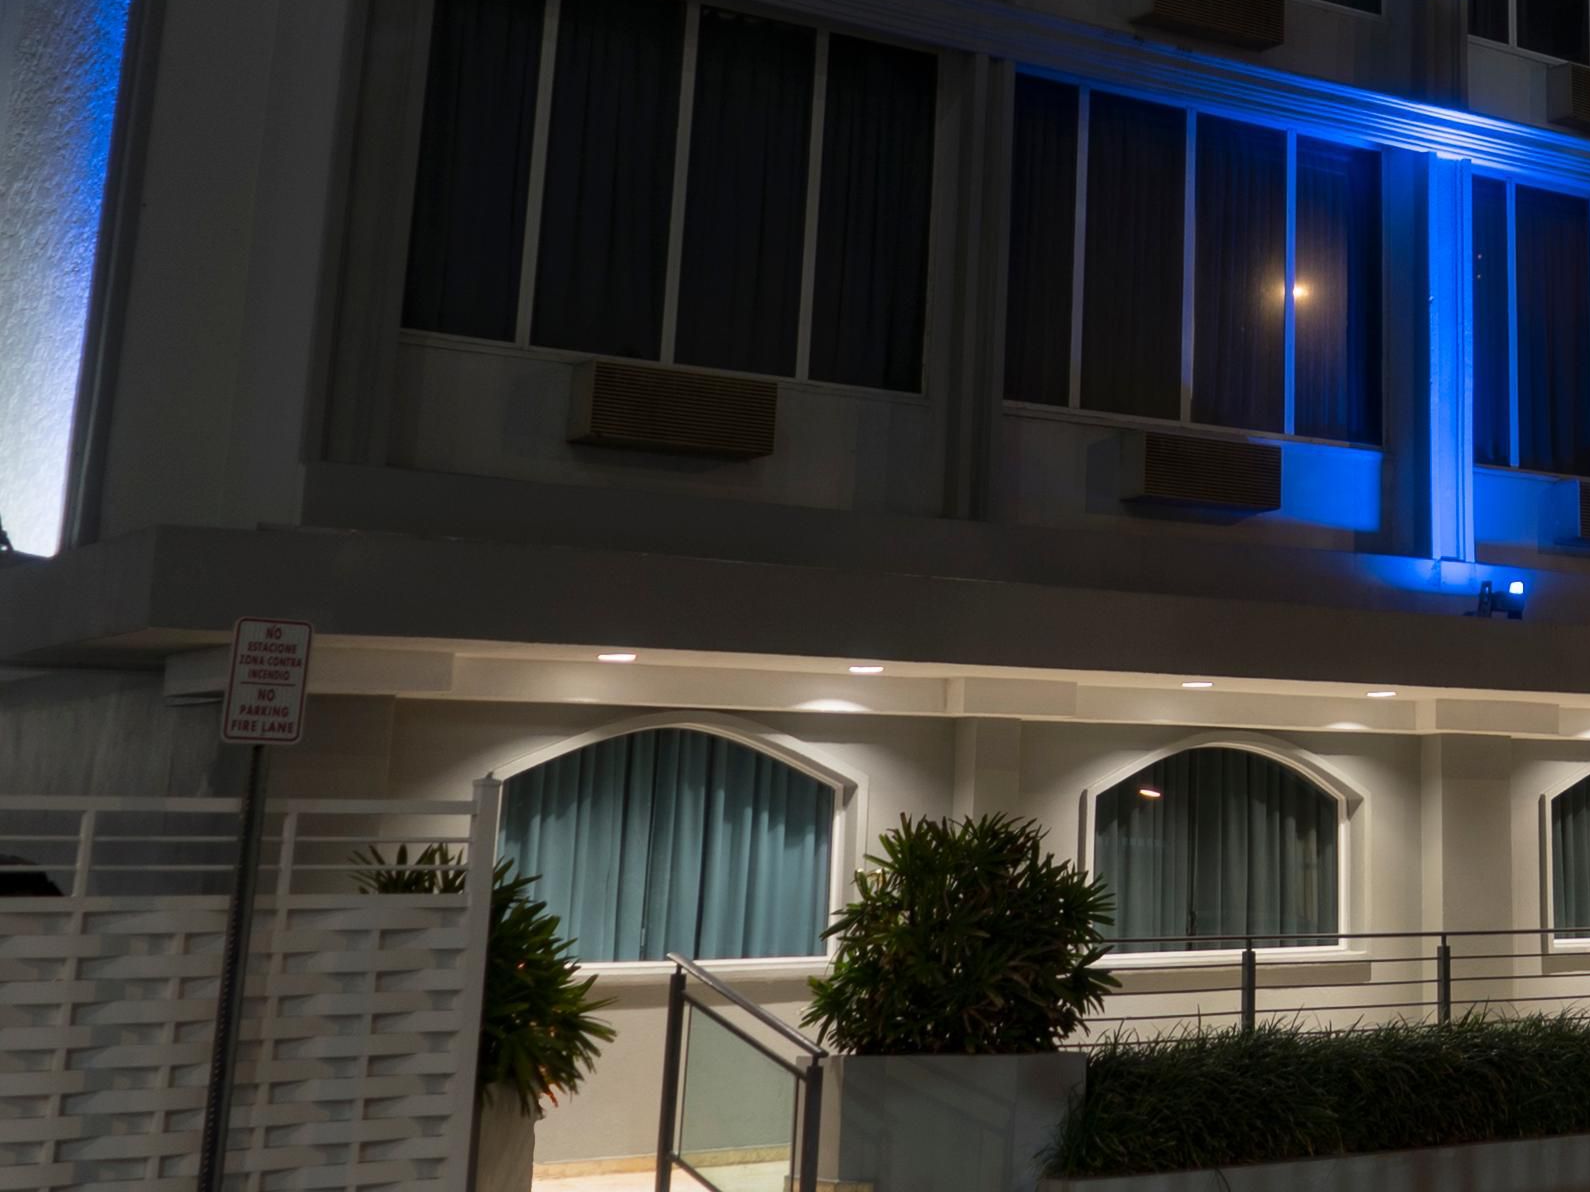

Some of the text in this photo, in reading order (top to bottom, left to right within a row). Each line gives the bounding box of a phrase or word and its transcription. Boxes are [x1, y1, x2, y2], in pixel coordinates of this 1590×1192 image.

[265, 627, 282, 640] NO
[248, 642, 297, 654] ESTACIONE
[239, 654, 303, 668] ZONA CONTRA
[257, 689, 275, 701] NO
[240, 704, 289, 717] PARKING
[231, 719, 295, 734] FIRE LANE
